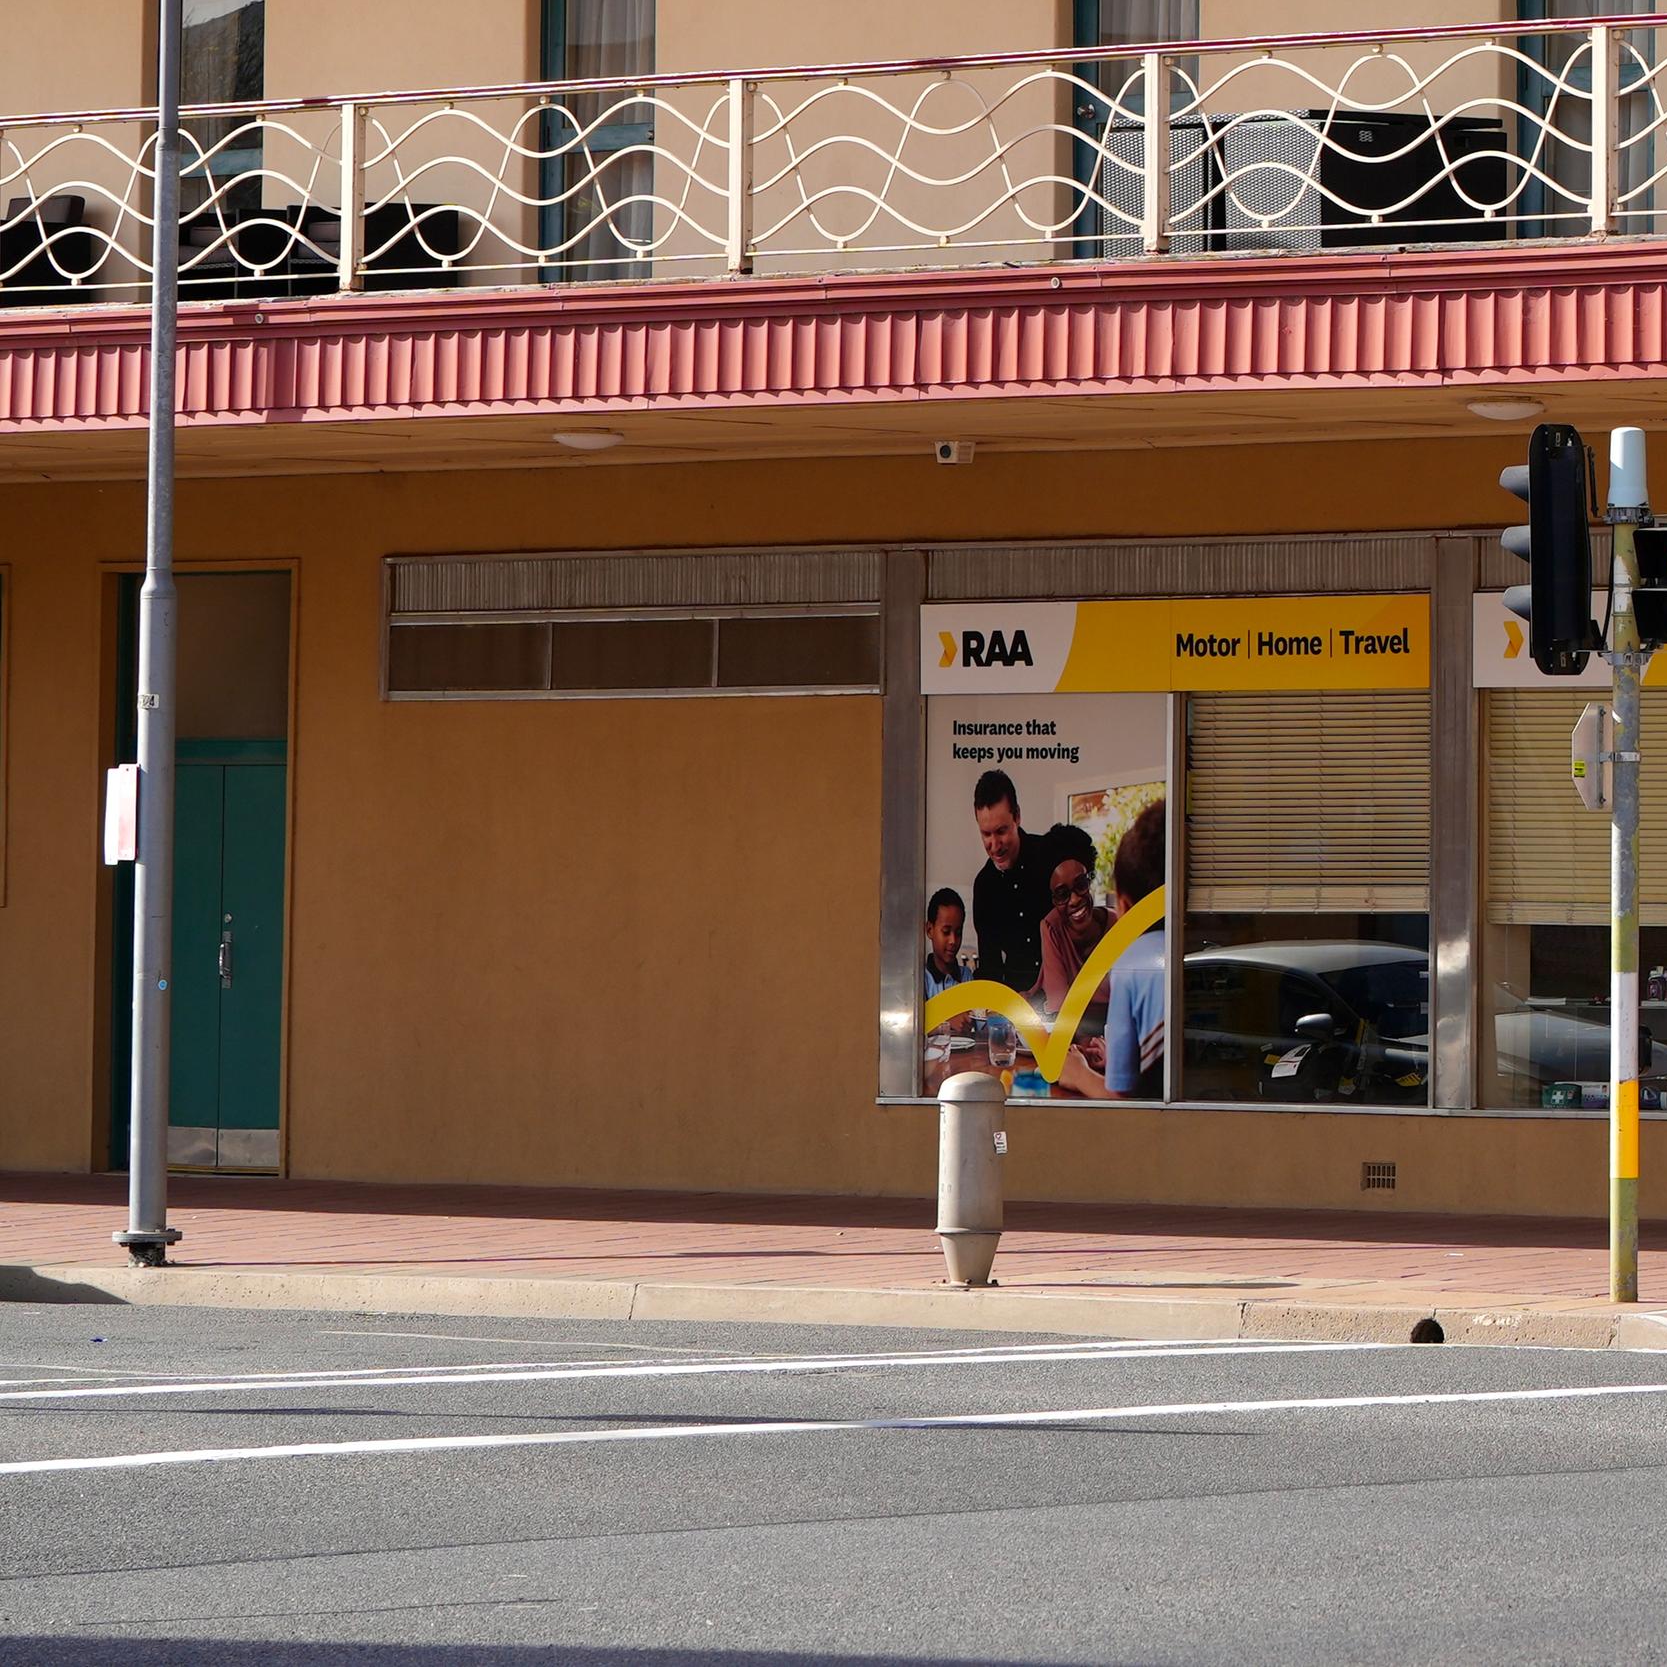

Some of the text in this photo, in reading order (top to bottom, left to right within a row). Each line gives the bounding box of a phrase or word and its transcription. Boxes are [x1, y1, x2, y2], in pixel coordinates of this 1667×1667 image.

[962, 630, 1034, 667] RAA
[1176, 627, 1410, 657] Motor Home Travel
[953, 719, 1056, 735] Insurance that
[953, 743, 1079, 763] keeps you moving
